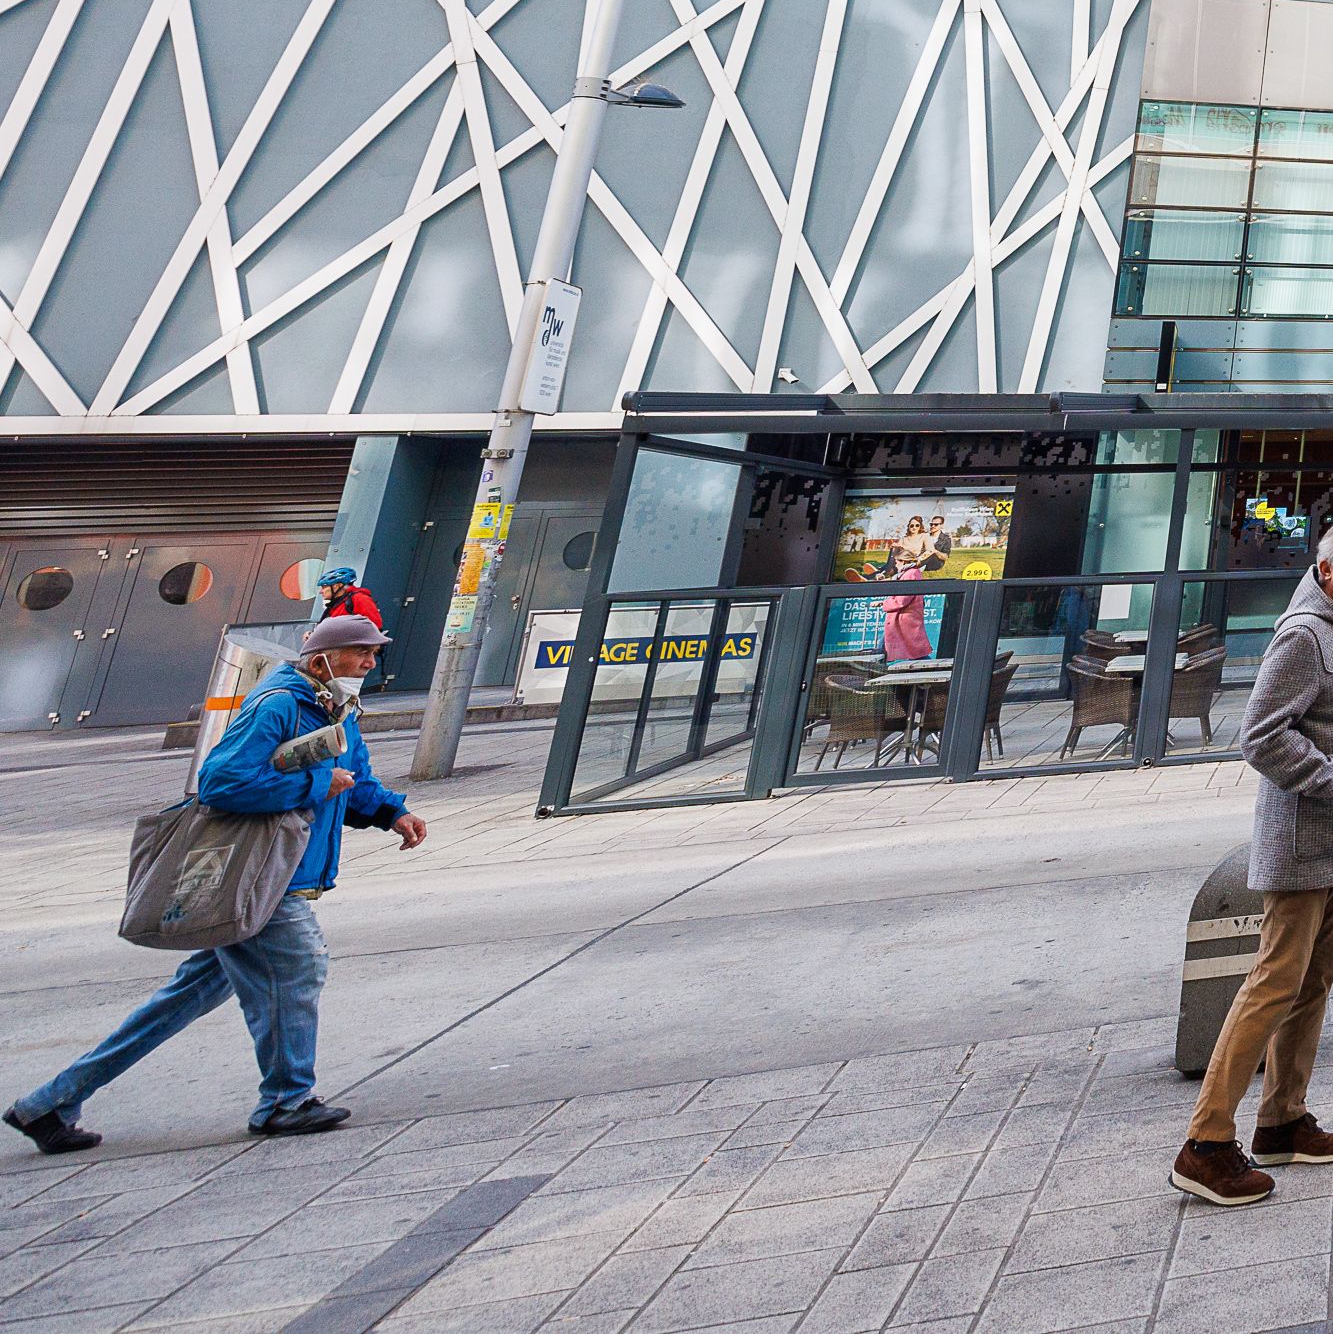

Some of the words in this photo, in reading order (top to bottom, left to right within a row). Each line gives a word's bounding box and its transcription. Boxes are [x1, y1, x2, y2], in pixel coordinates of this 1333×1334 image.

[844, 602, 866, 611] DAS
[842, 610, 887, 621] LIFESTY
[546, 642, 640, 665] VIAGE
